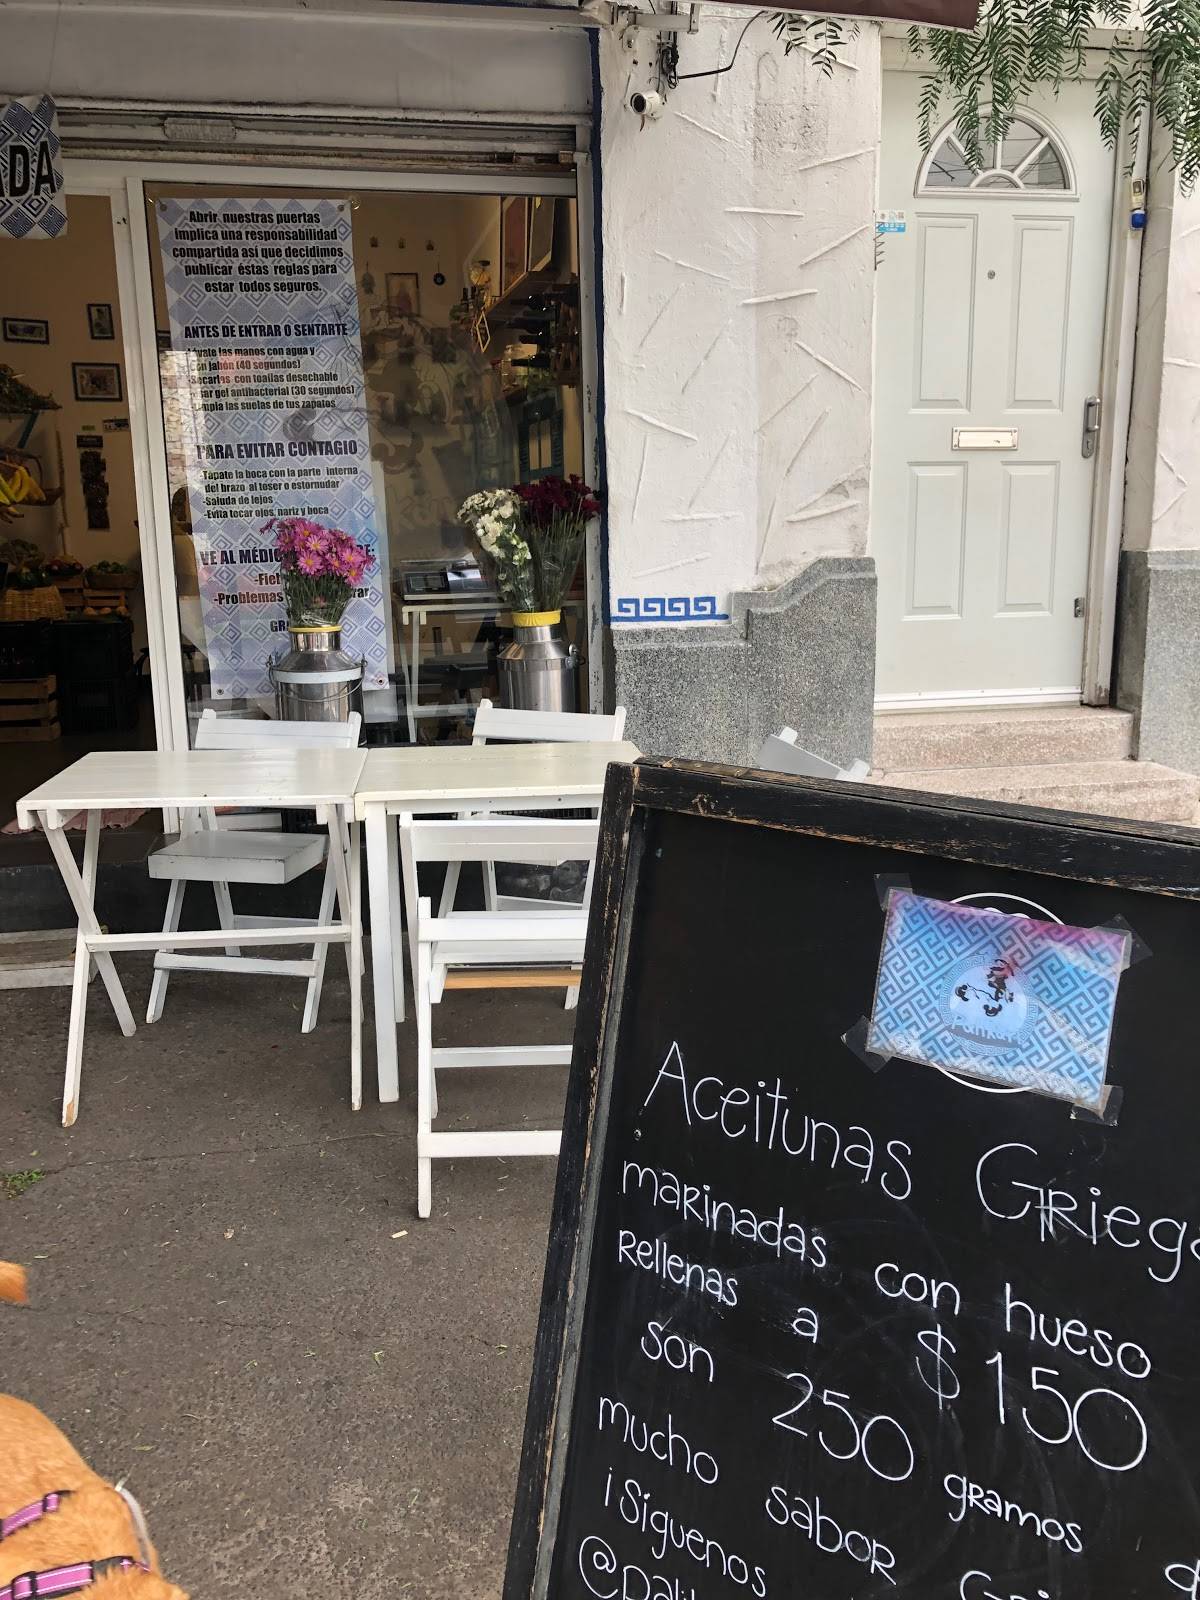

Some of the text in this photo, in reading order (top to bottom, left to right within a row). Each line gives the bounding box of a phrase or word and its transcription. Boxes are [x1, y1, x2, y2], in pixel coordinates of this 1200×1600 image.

[189, 211, 321, 225] Abrir nuestras puertas
[174, 228, 338, 242] implica una responsabilidad
[172, 245, 344, 261] compartida así que decidimos
[184, 264, 233, 277] publicar
[273, 263, 310, 276] reglas
[312, 265, 338, 276] para
[204, 281, 322, 294] estar todos seguros.
[184, 323, 348, 339] ANTES DE ENTRAR O SENTARTE
[218, 347, 233, 356] las
[234, 347, 266, 356] manos
[266, 347, 284, 356] con
[286, 347, 309, 357] agua
[310, 346, 315, 356] y
[236, 360, 252, 370] (40
[253, 360, 301, 371] segundos)
[234, 375, 252, 384] con
[253, 372, 285, 382] toallas
[286, 372, 339, 382] desechable
[214, 388, 230, 399] gel
[230, 386, 290, 397] antibacterial
[291, 385, 307, 396] (30
[308, 385, 355, 396] segundos)
[225, 401, 240, 411] las
[240, 400, 272, 410] suelas
[272, 400, 284, 409] de
[286, 400, 301, 408] tus
[301, 399, 337, 409] zapatos
[196, 440, 358, 460] PARA EVITAR CONTAGIO
[235, 469, 244, 479] la
[245, 468, 268, 479] boca
[269, 469, 286, 478] con
[287, 468, 296, 477] la
[297, 467, 322, 478] parte
[326, 467, 359, 476] interna
[204, 480, 340, 493] del brazo al toser o estornudar
[202, 495, 273, 506] -Saluda de lejos
[203, 510, 229, 519] -Evita
[229, 509, 253, 518] tocar
[277, 507, 299, 516] nariz
[300, 508, 306, 517] y
[307, 505, 329, 515] boca
[200, 550, 218, 566] VE
[220, 549, 237, 565] AL
[213, 591, 284, 605] -Problemas
[643, 1041, 913, 1200] Aceitunas
[874, 1261, 961, 1316] con
[1004, 1283, 1152, 1380] hueso
[617, 1229, 739, 1307] Rellenas
[793, 1307, 819, 1344] a
[985, 1352, 1148, 1472] 150
[640, 1318, 714, 1383] son
[771, 1372, 915, 1482] 250
[598, 1396, 720, 1485] mucho
